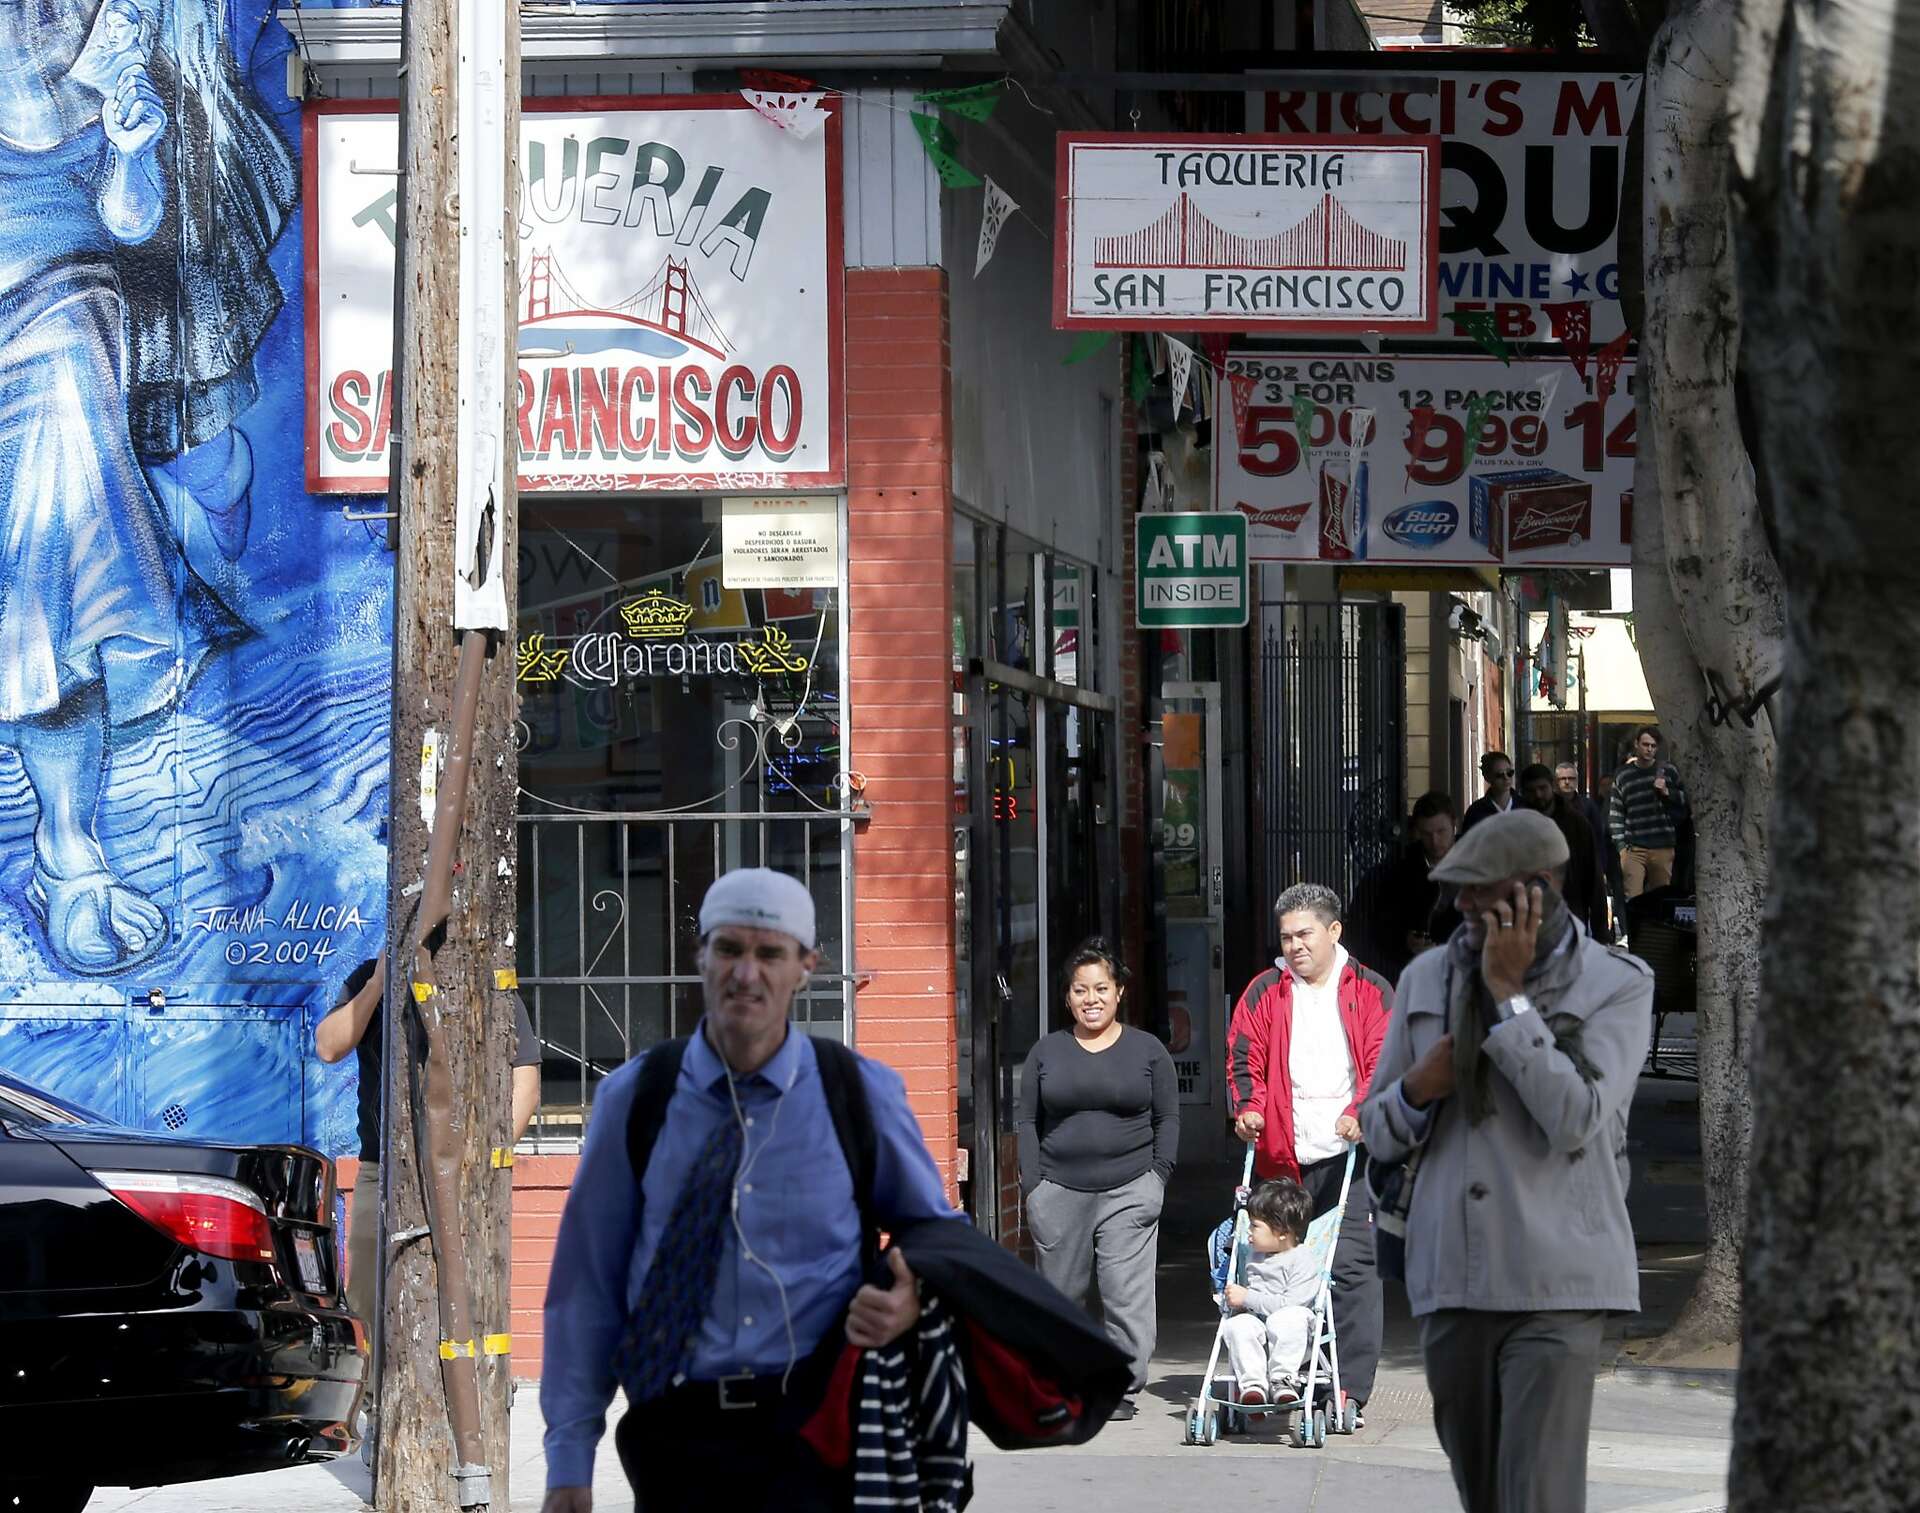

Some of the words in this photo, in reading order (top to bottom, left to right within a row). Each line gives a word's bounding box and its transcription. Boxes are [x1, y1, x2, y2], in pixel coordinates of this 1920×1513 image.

[1264, 79, 1524, 137] RICCI'S
[1552, 80, 1634, 137] M
[1154, 152, 1344, 190] TAQUERIA
[352, 137, 772, 282] TUERIA
[1093, 273, 1165, 311] SAN
[1204, 274, 1404, 311] FRANCISCO
[1227, 360, 1299, 381] 25oz
[1309, 361, 1395, 383] CANS
[1265, 383, 1282, 403] 3
[1294, 383, 1354, 404] FOR
[1398, 390, 1433, 409] 12
[1445, 390, 1545, 411] PACKS
[517, 365, 805, 463] RANCISCO
[1394, 521, 1456, 534] LIGHT
[1404, 510, 1450, 522] BUD
[1147, 534, 1237, 568] ATM
[1151, 583, 1234, 602] INSIDE
[572, 632, 740, 687] Corona
[190, 904, 277, 934] JUANA
[282, 899, 377, 936] ALICIA
[1174, 1061, 1200, 1076] THE
